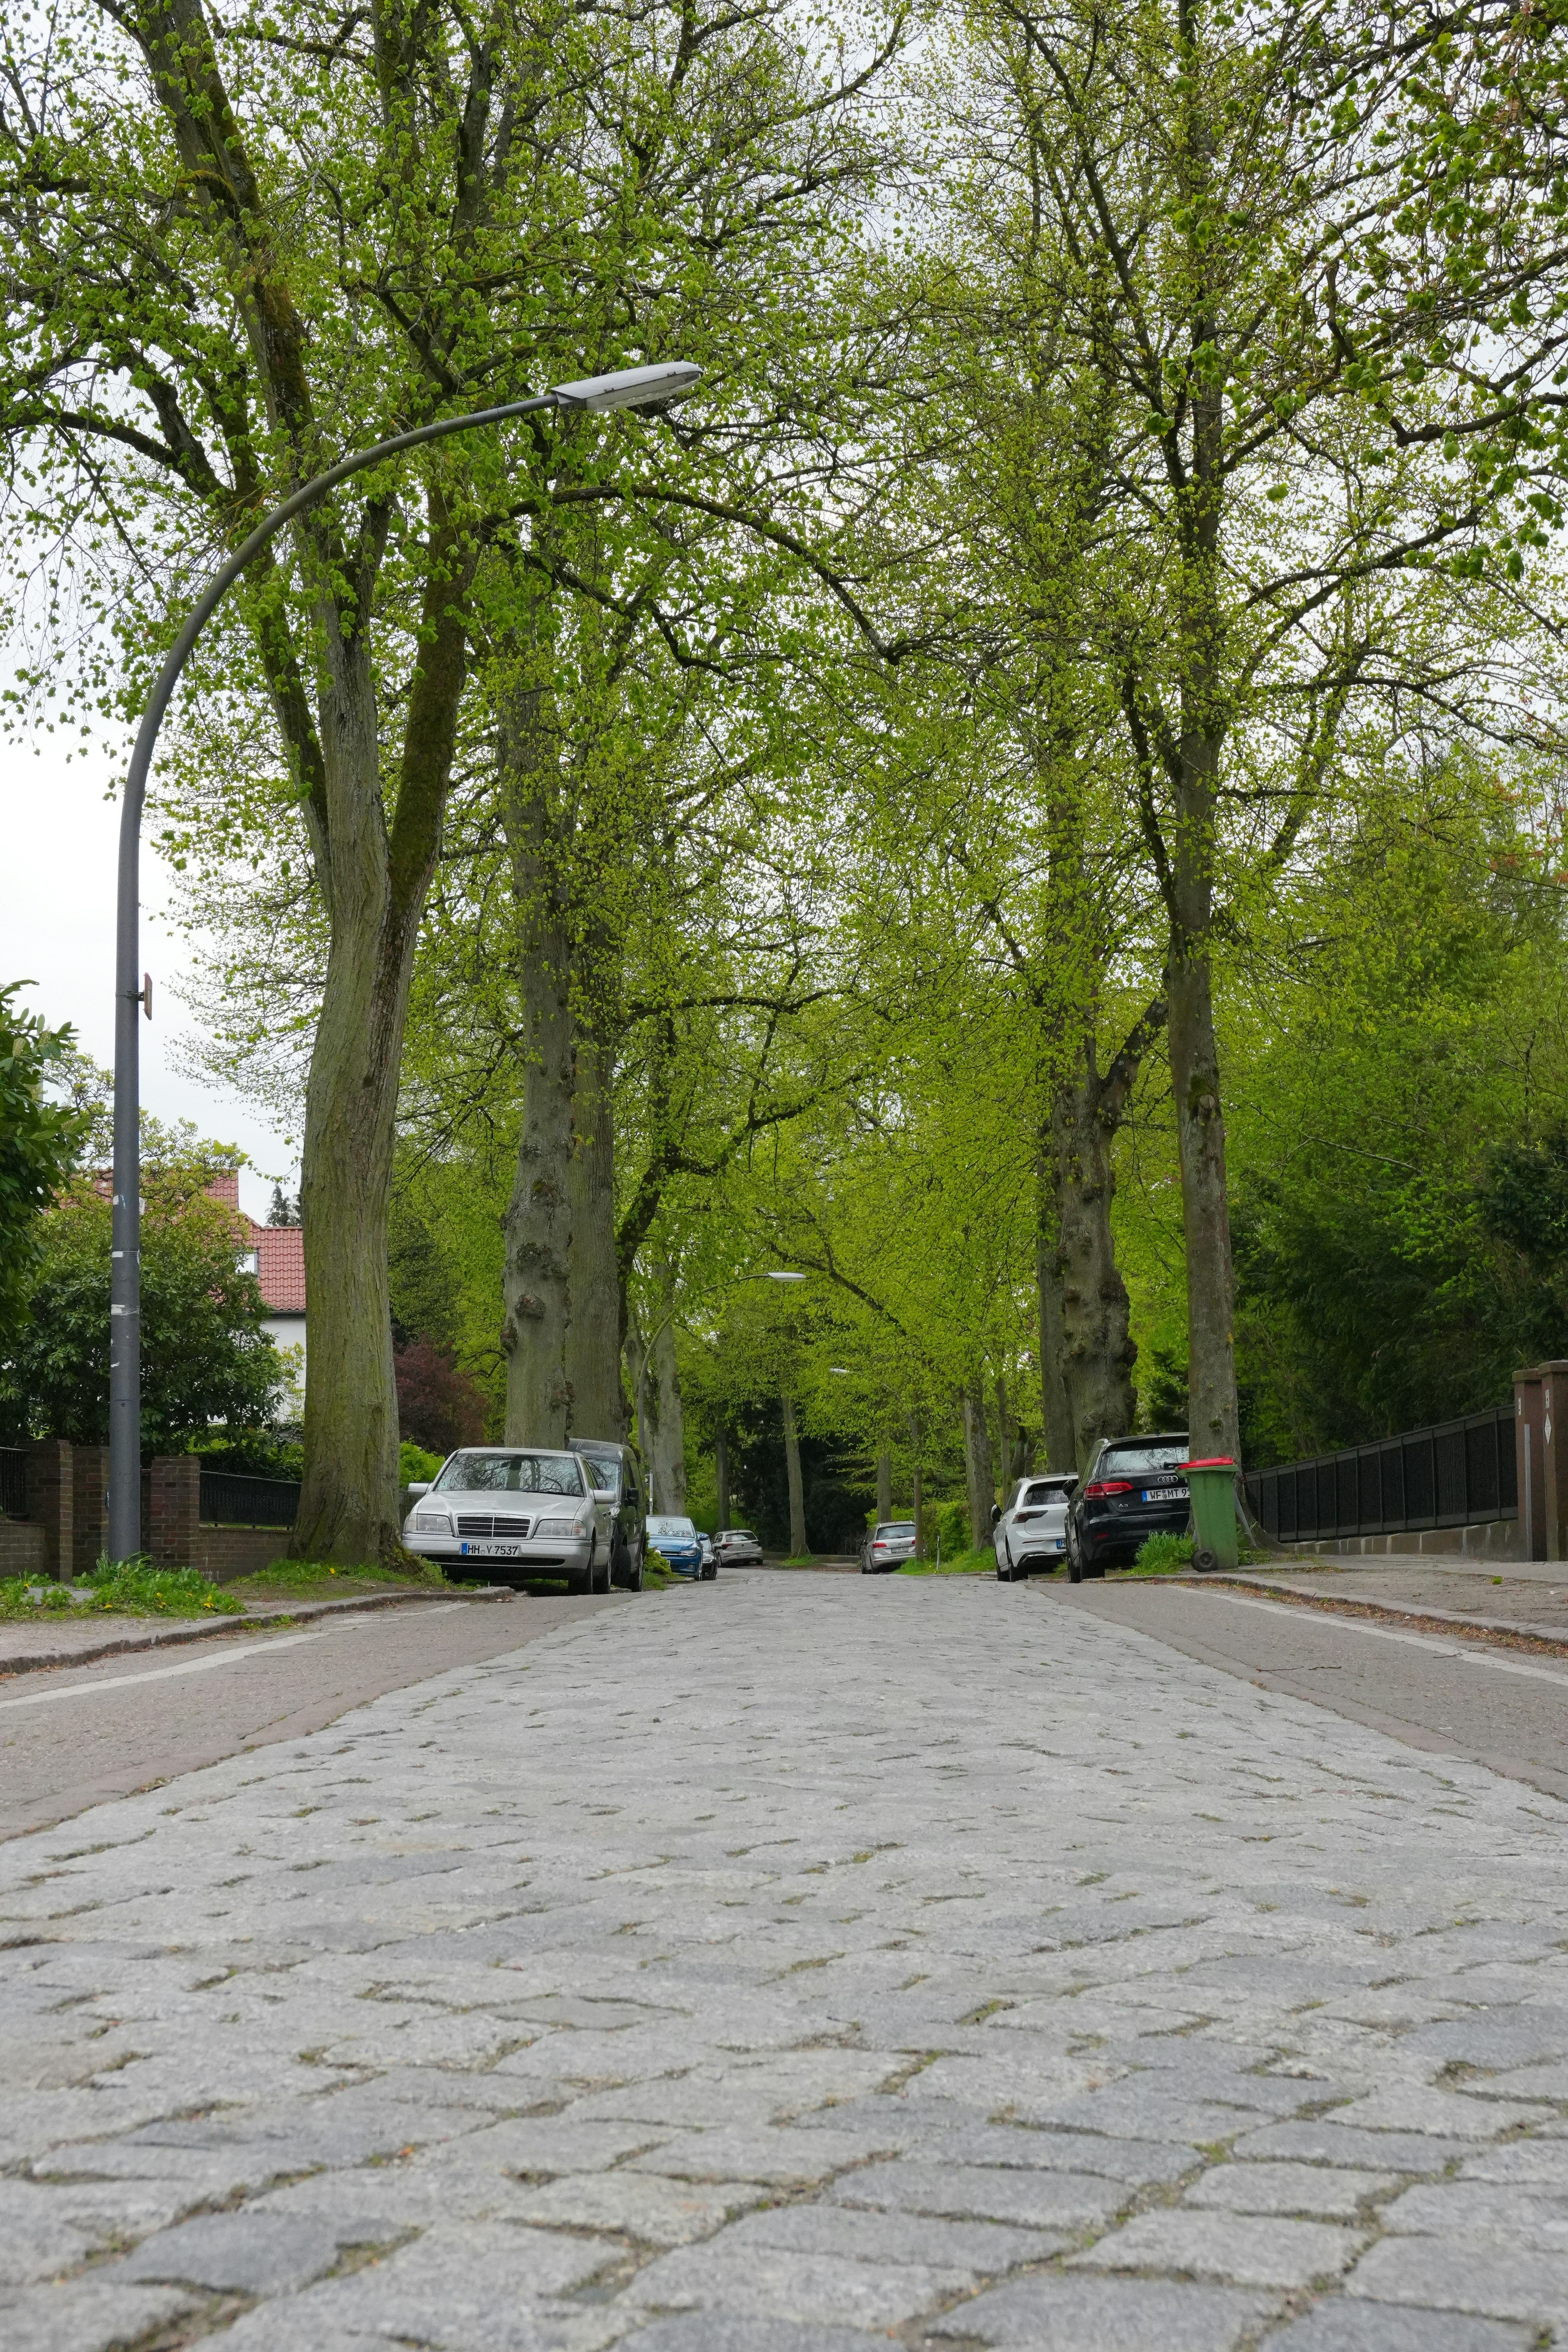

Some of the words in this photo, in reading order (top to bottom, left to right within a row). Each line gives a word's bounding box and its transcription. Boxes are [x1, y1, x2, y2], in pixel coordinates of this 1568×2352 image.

[1150, 1491, 1161, 1500] WF
[1168, 1489, 1179, 1498] MT
[468, 1544, 480, 1554] HH
[486, 1545, 493, 1554] Y
[495, 1546, 518, 1555] 7537
